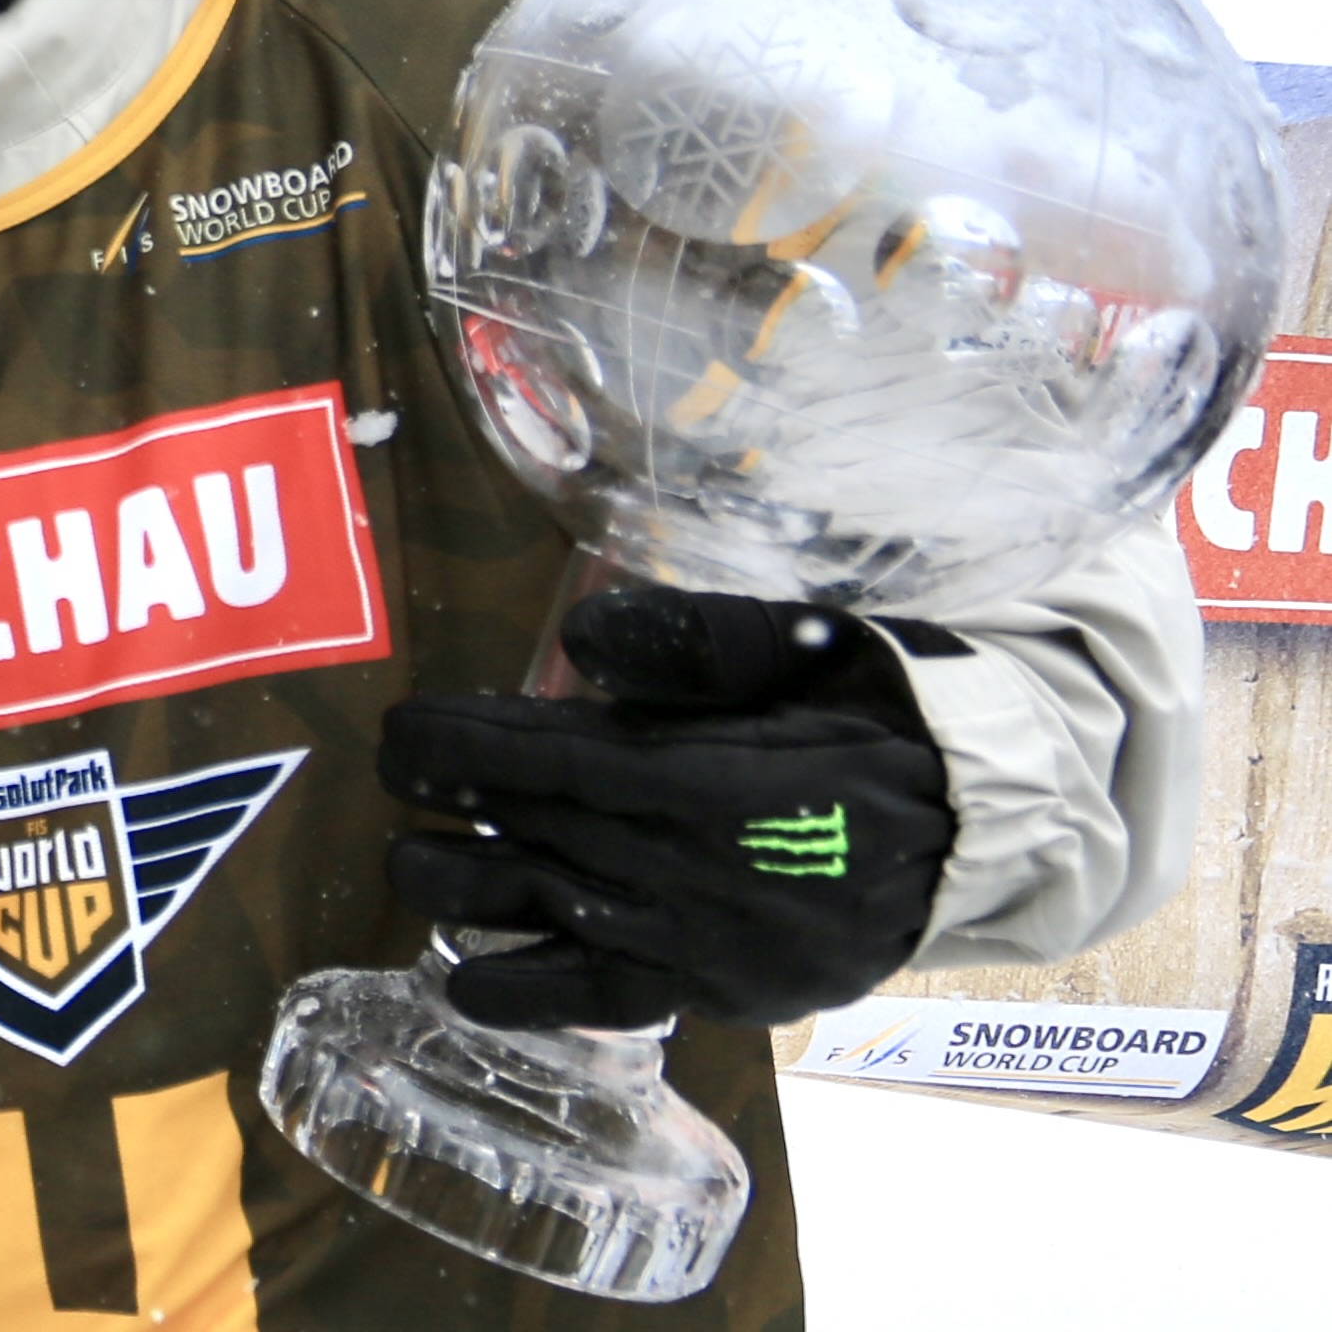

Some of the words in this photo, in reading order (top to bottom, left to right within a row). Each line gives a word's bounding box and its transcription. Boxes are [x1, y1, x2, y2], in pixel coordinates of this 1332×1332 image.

[168, 140, 353, 223] SNOWBOARD
[175, 201, 275, 247] WORLD
[282, 188, 332, 221] CUP
[27, 819, 49, 837] FIS
[949, 1021, 1208, 1056] SNOWBOARD
[943, 1052, 1054, 1072] WORLD
[1060, 1055, 1119, 1074] CUP
